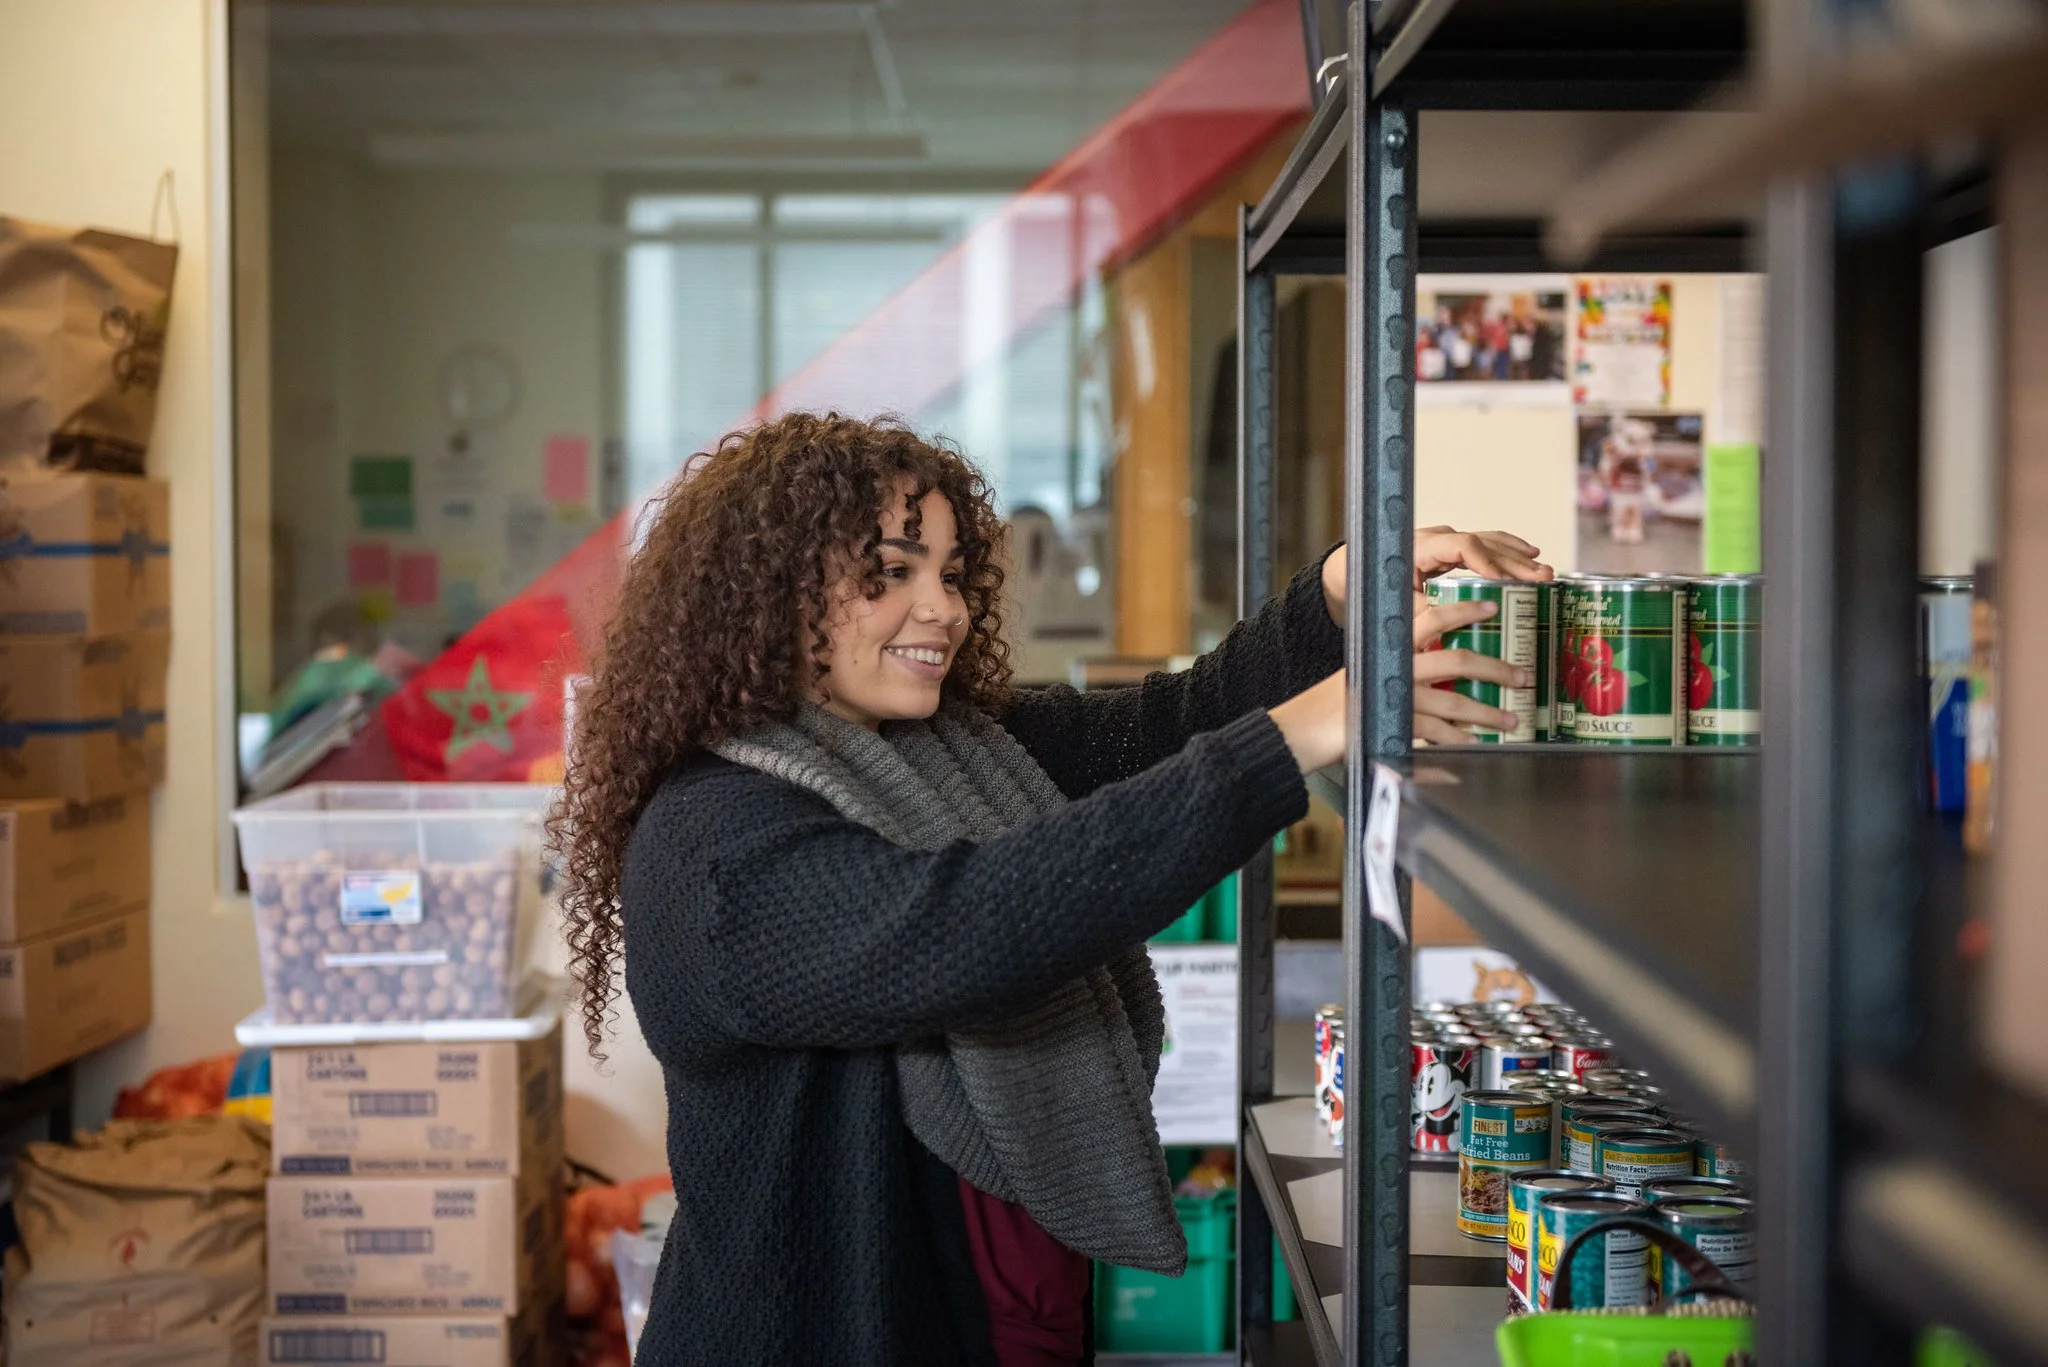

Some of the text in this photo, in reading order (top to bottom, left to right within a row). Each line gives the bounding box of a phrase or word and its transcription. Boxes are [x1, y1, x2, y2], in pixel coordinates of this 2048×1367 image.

[1592, 718, 1634, 733] SAUCE
[1473, 1120, 1505, 1134] FINEST
[1470, 1135, 1509, 1148] Fat Free
[1494, 1150, 1531, 1161] Beans
[1606, 1163, 1629, 1172] Nutrition
[1629, 1166, 1647, 1174] Facts
[1701, 1245, 1722, 1253] Datos
[1723, 1245, 1732, 1253] De
